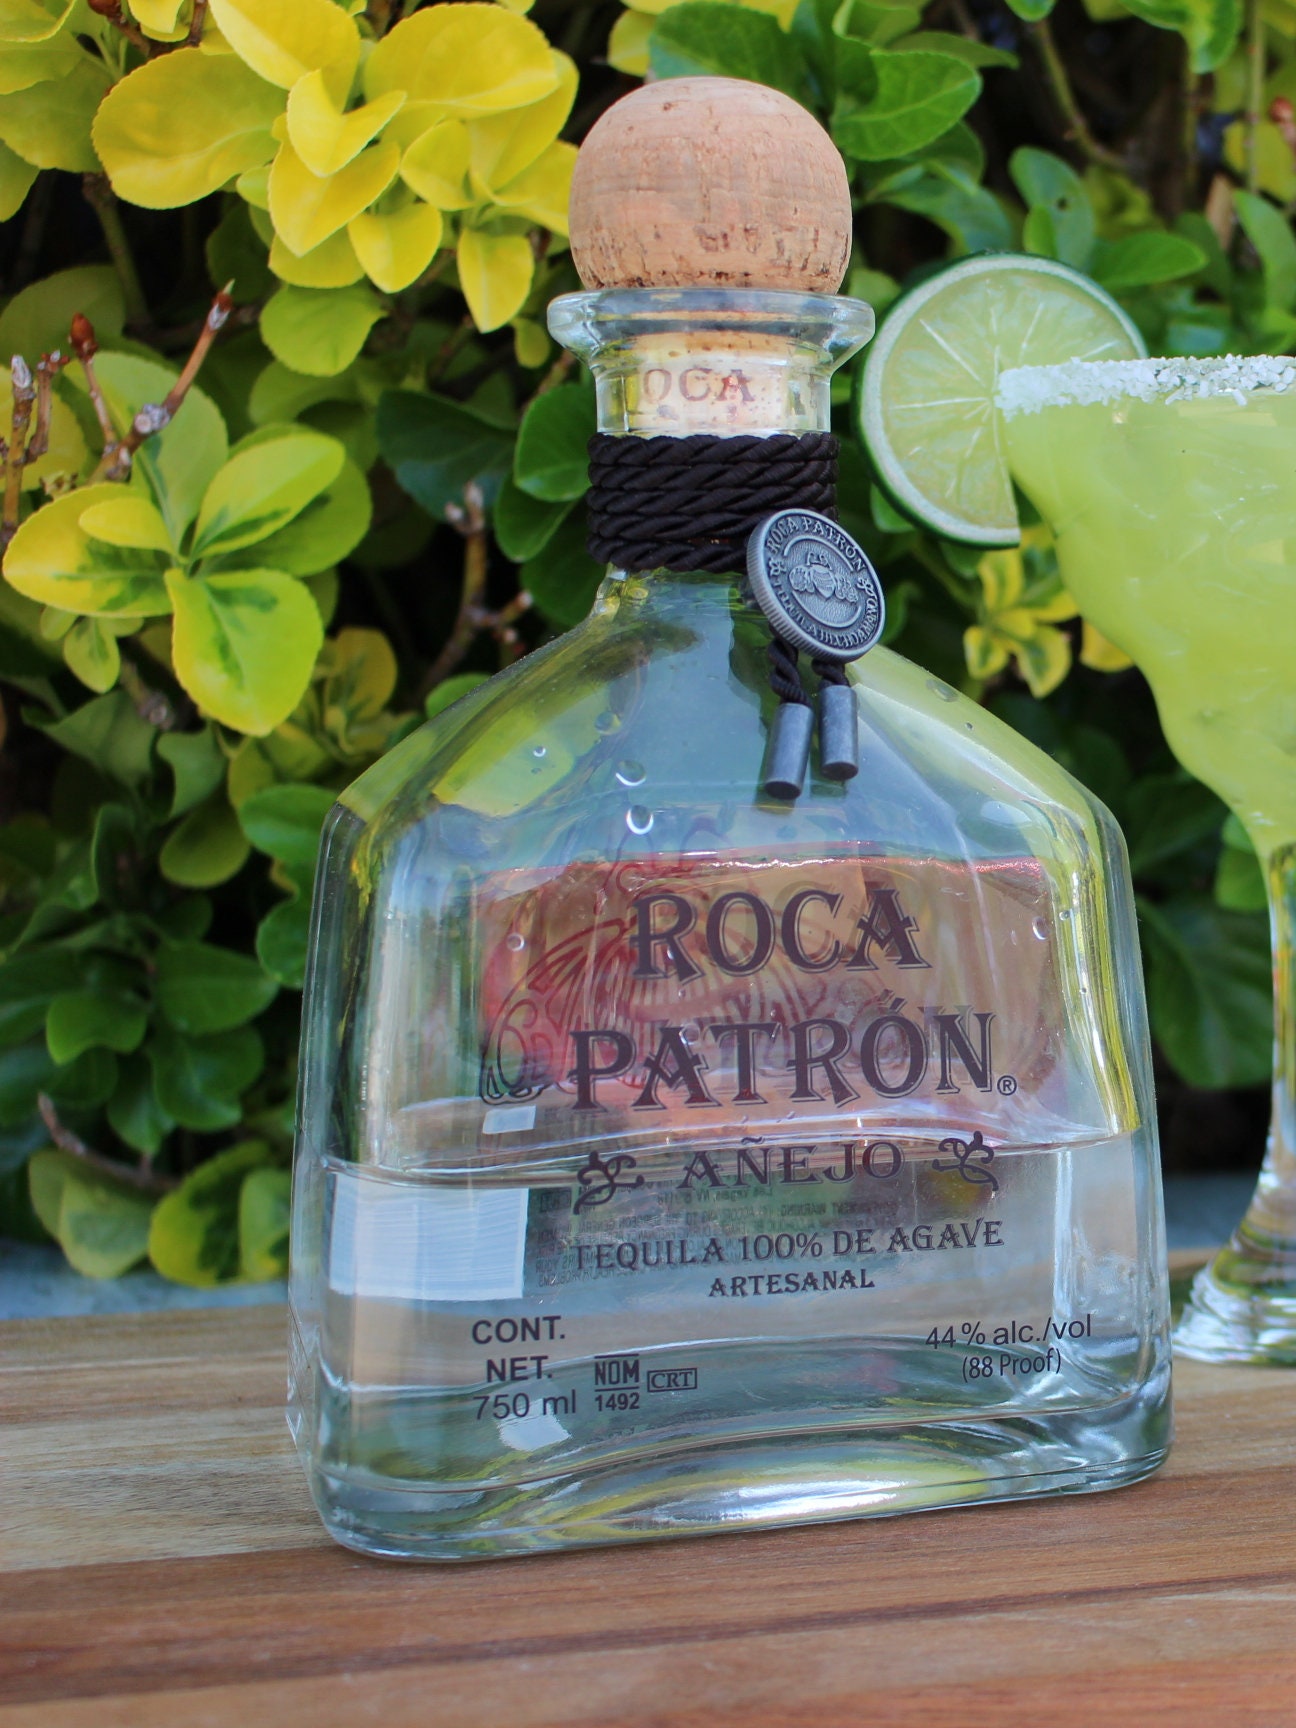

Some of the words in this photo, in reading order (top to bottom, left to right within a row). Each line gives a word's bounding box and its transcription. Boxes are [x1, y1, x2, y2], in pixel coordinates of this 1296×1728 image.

[767, 517, 799, 555] ROCA
[630, 888, 932, 984] ROCA
[677, 1137, 904, 1189] AÑEJO
[573, 1235, 726, 1271] TEQUILA
[739, 1231, 823, 1261] 100%
[832, 1227, 876, 1257] DE
[886, 1218, 1005, 1253] AGAVE
[708, 1269, 875, 1298] ARTESANAL
[471, 1315, 567, 1346] CONT.
[993, 1314, 1091, 1346] alc./vol
[486, 1356, 553, 1383] NET.
[594, 1359, 641, 1388] NOM
[651, 1371, 693, 1389] CRT
[961, 1356, 995, 1383] (88
[999, 1347, 1063, 1376] Proof)
[473, 1393, 529, 1421] 750
[541, 1388, 578, 1416] ml
[594, 1394, 641, 1413] 1492
